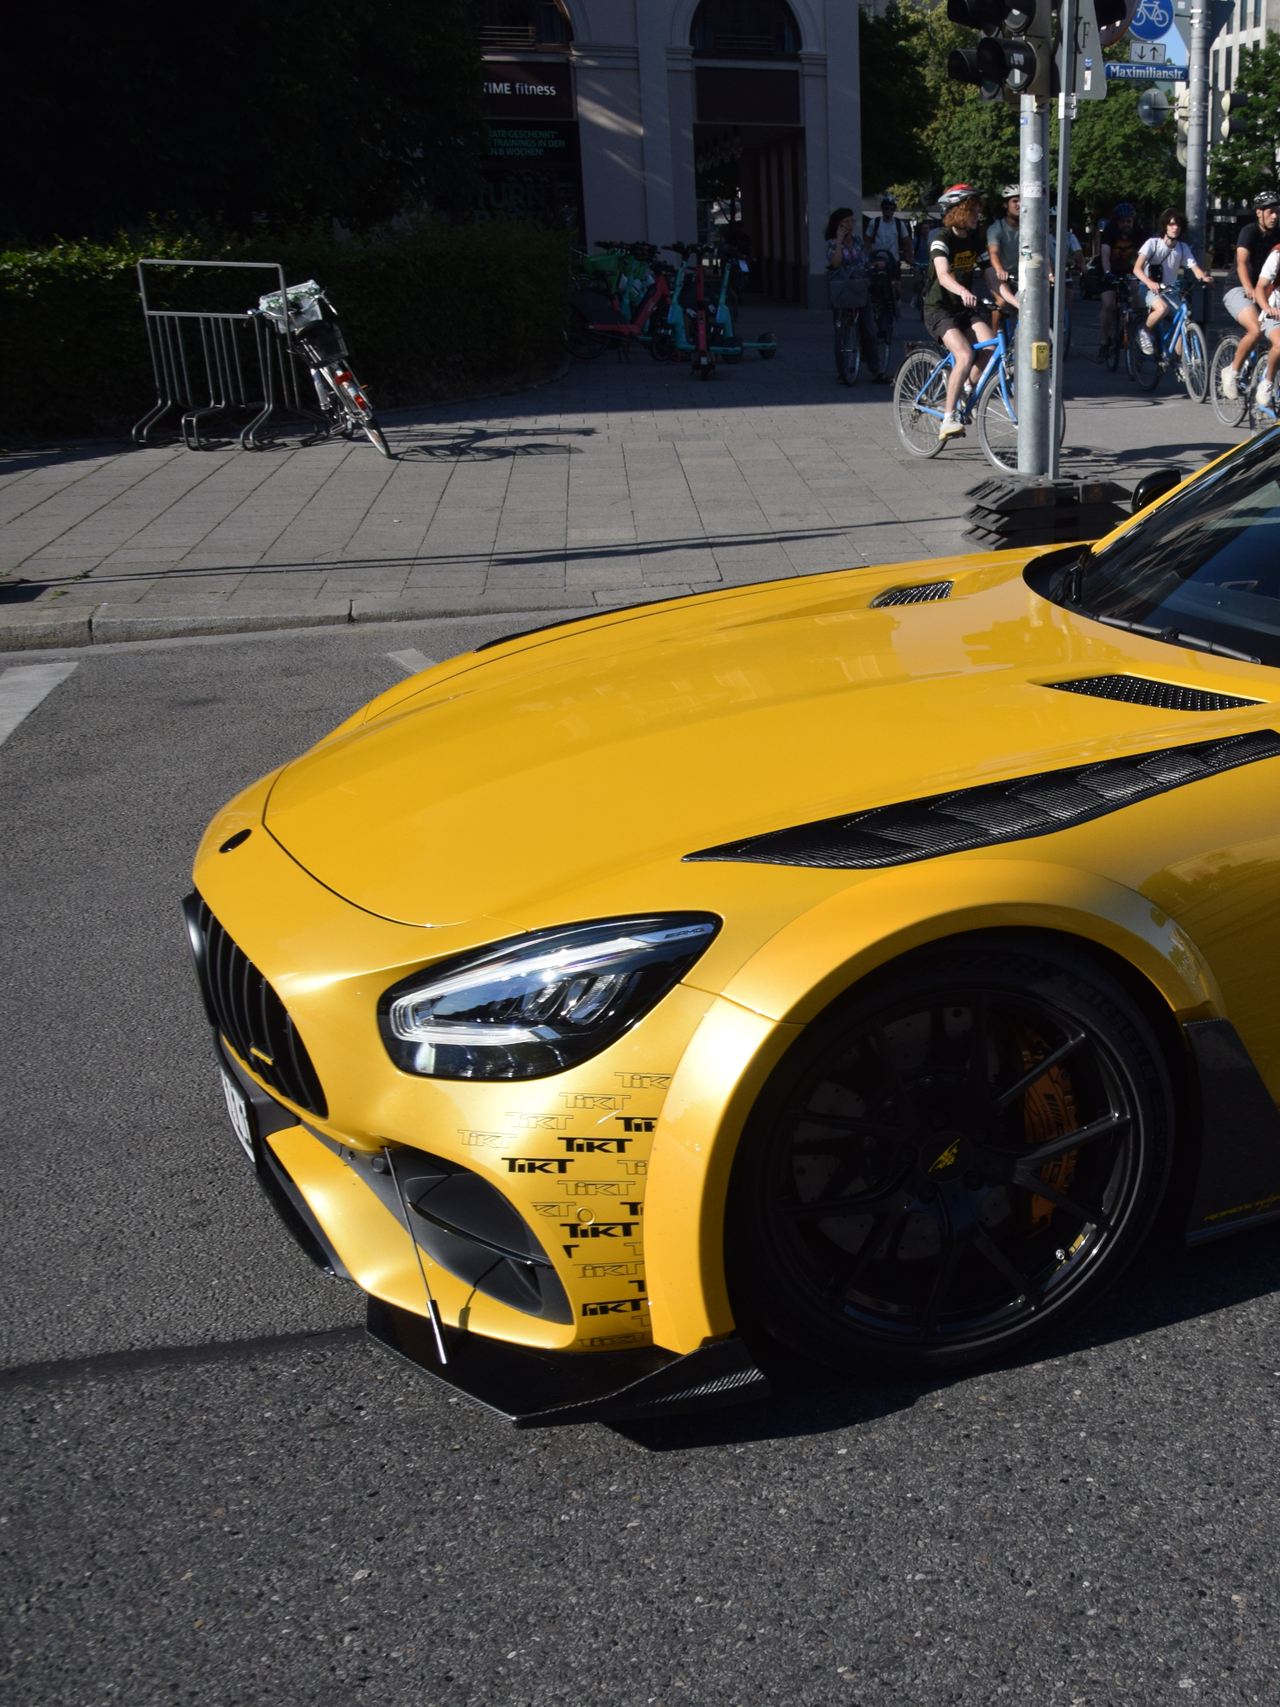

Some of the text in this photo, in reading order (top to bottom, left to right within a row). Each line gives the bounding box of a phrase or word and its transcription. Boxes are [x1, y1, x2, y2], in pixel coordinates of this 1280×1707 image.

[1110, 65, 1184, 79] Maximilianstr.
[515, 82, 557, 96] fitness
[493, 139, 536, 147] TRAININGS
[548, 140, 565, 148] DEN
[1073, 982, 1157, 1080] MICHELIN
